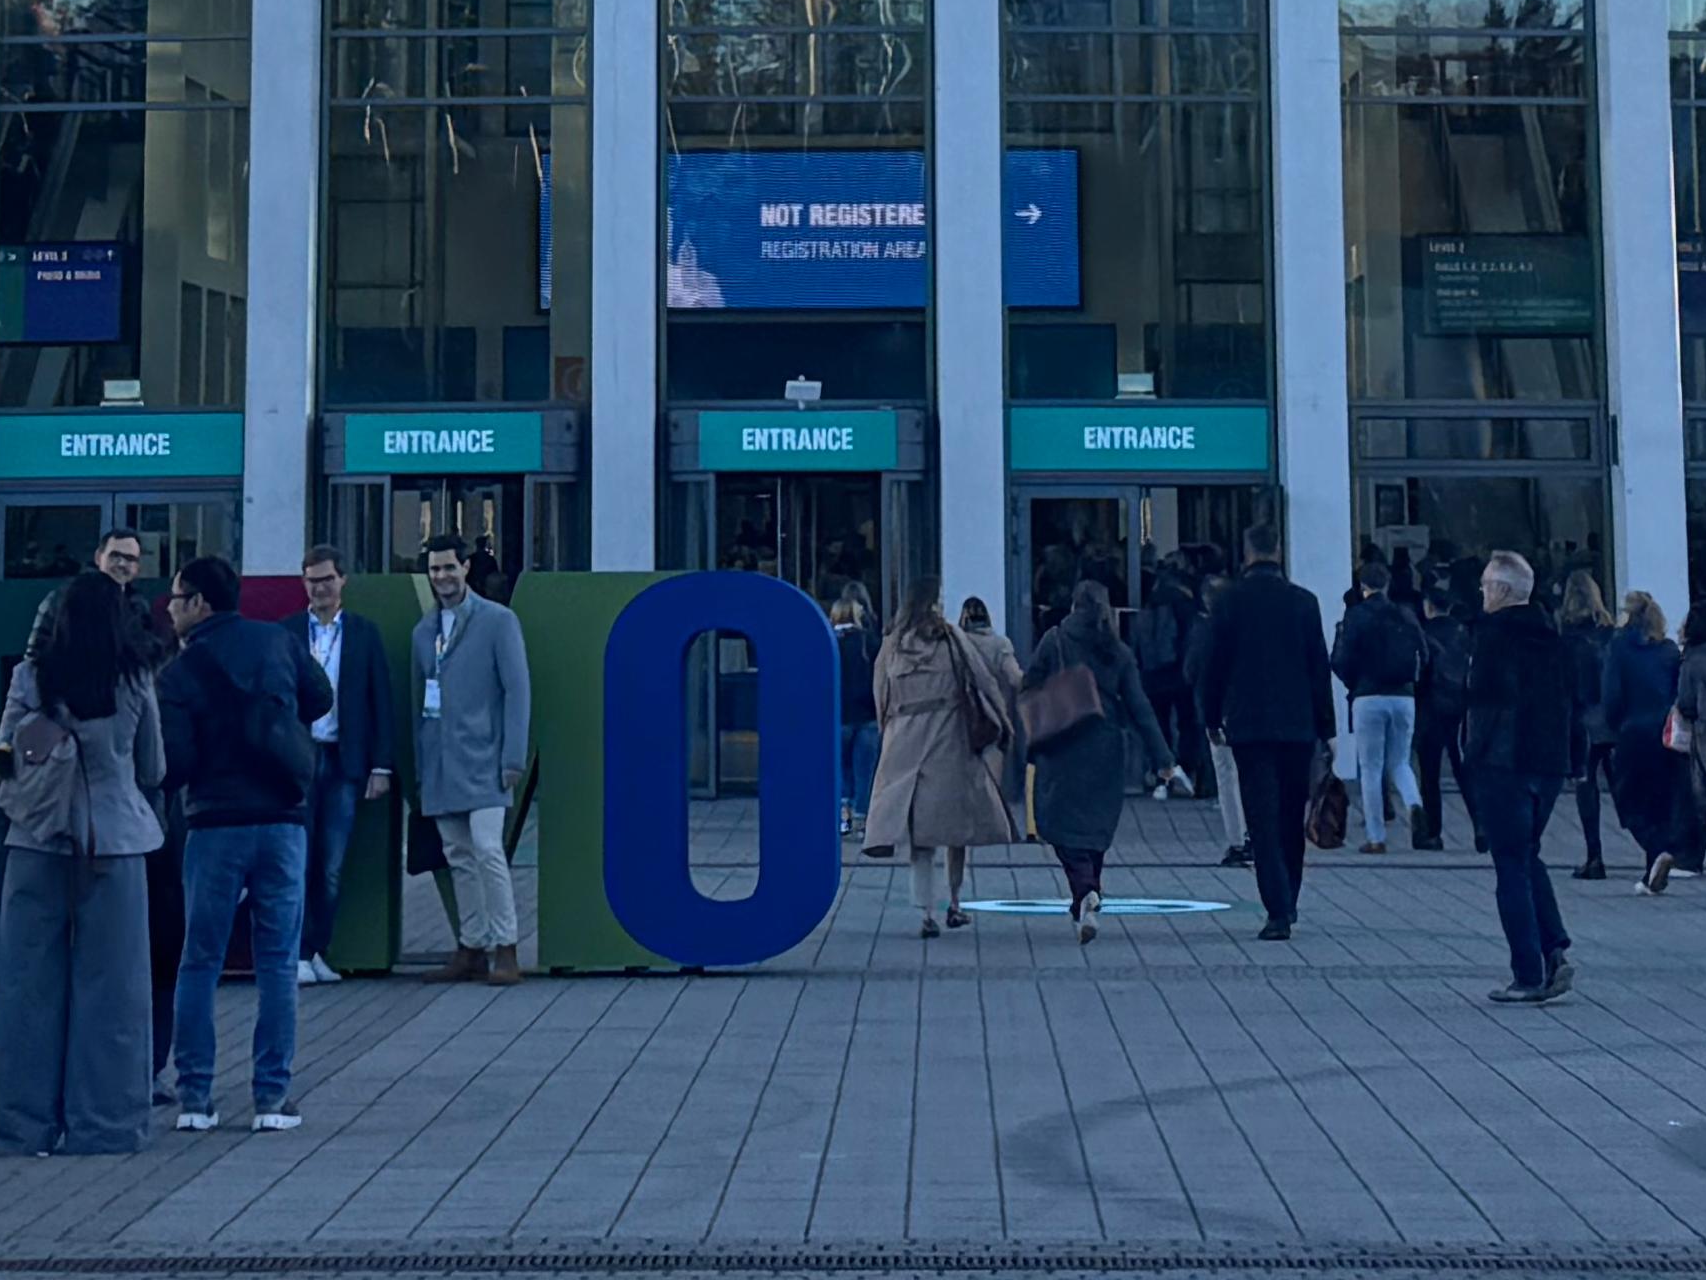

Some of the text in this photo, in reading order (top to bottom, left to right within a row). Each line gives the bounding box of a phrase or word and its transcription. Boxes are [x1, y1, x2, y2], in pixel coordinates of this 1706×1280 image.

[760, 203, 926, 227] NOT REGISTERE
[760, 241, 926, 259] REGISTRATION AREA
[61, 432, 170, 458] ENTRANCE
[384, 428, 494, 454] ENTRANCE
[742, 427, 853, 451] ENTRANCE
[1084, 426, 1195, 450] ENTRANCE
